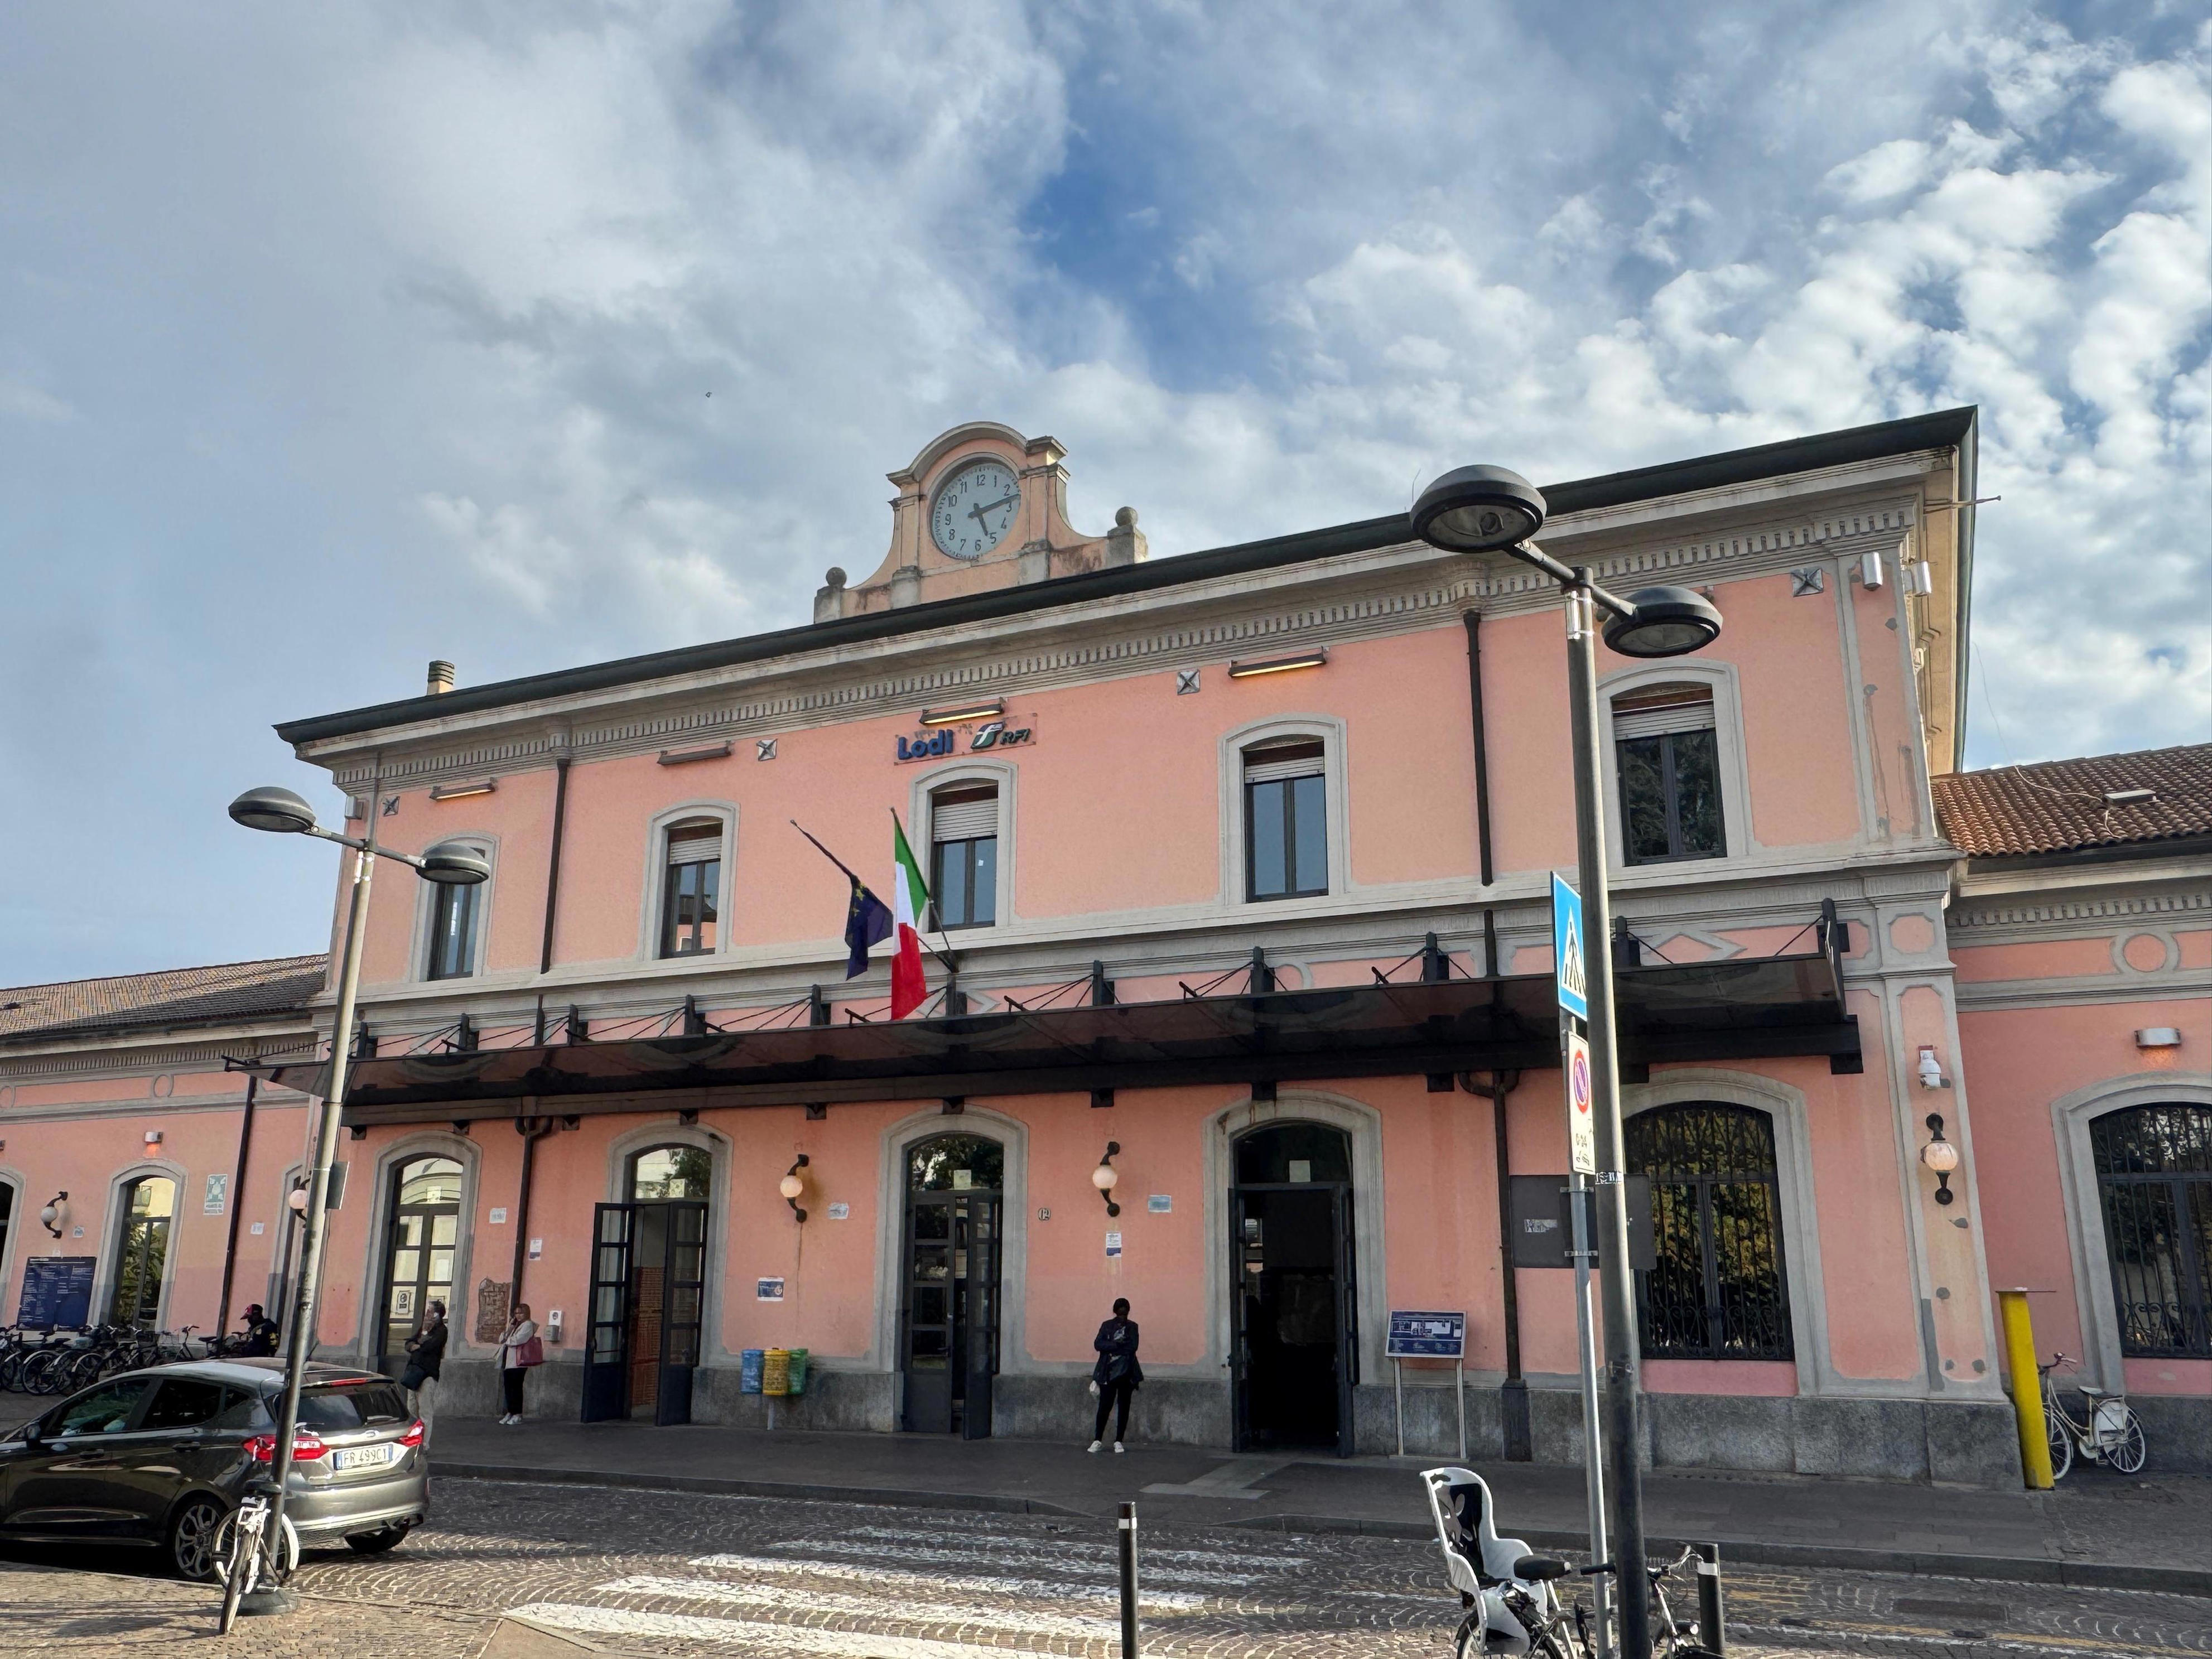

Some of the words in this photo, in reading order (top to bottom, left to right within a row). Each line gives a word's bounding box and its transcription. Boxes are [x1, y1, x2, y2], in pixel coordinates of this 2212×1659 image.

[977, 474, 985, 486] 12
[994, 475, 997, 487] 1
[960, 481, 967, 494] 11
[1004, 484, 1010, 496] 2
[948, 495, 957, 507] 10
[1006, 501, 1012, 512] 3
[945, 514, 951, 525] 9
[949, 529, 955, 541] 8
[989, 532, 996, 544] 5
[960, 539, 966, 551] 7
[975, 539, 981, 551] 6
